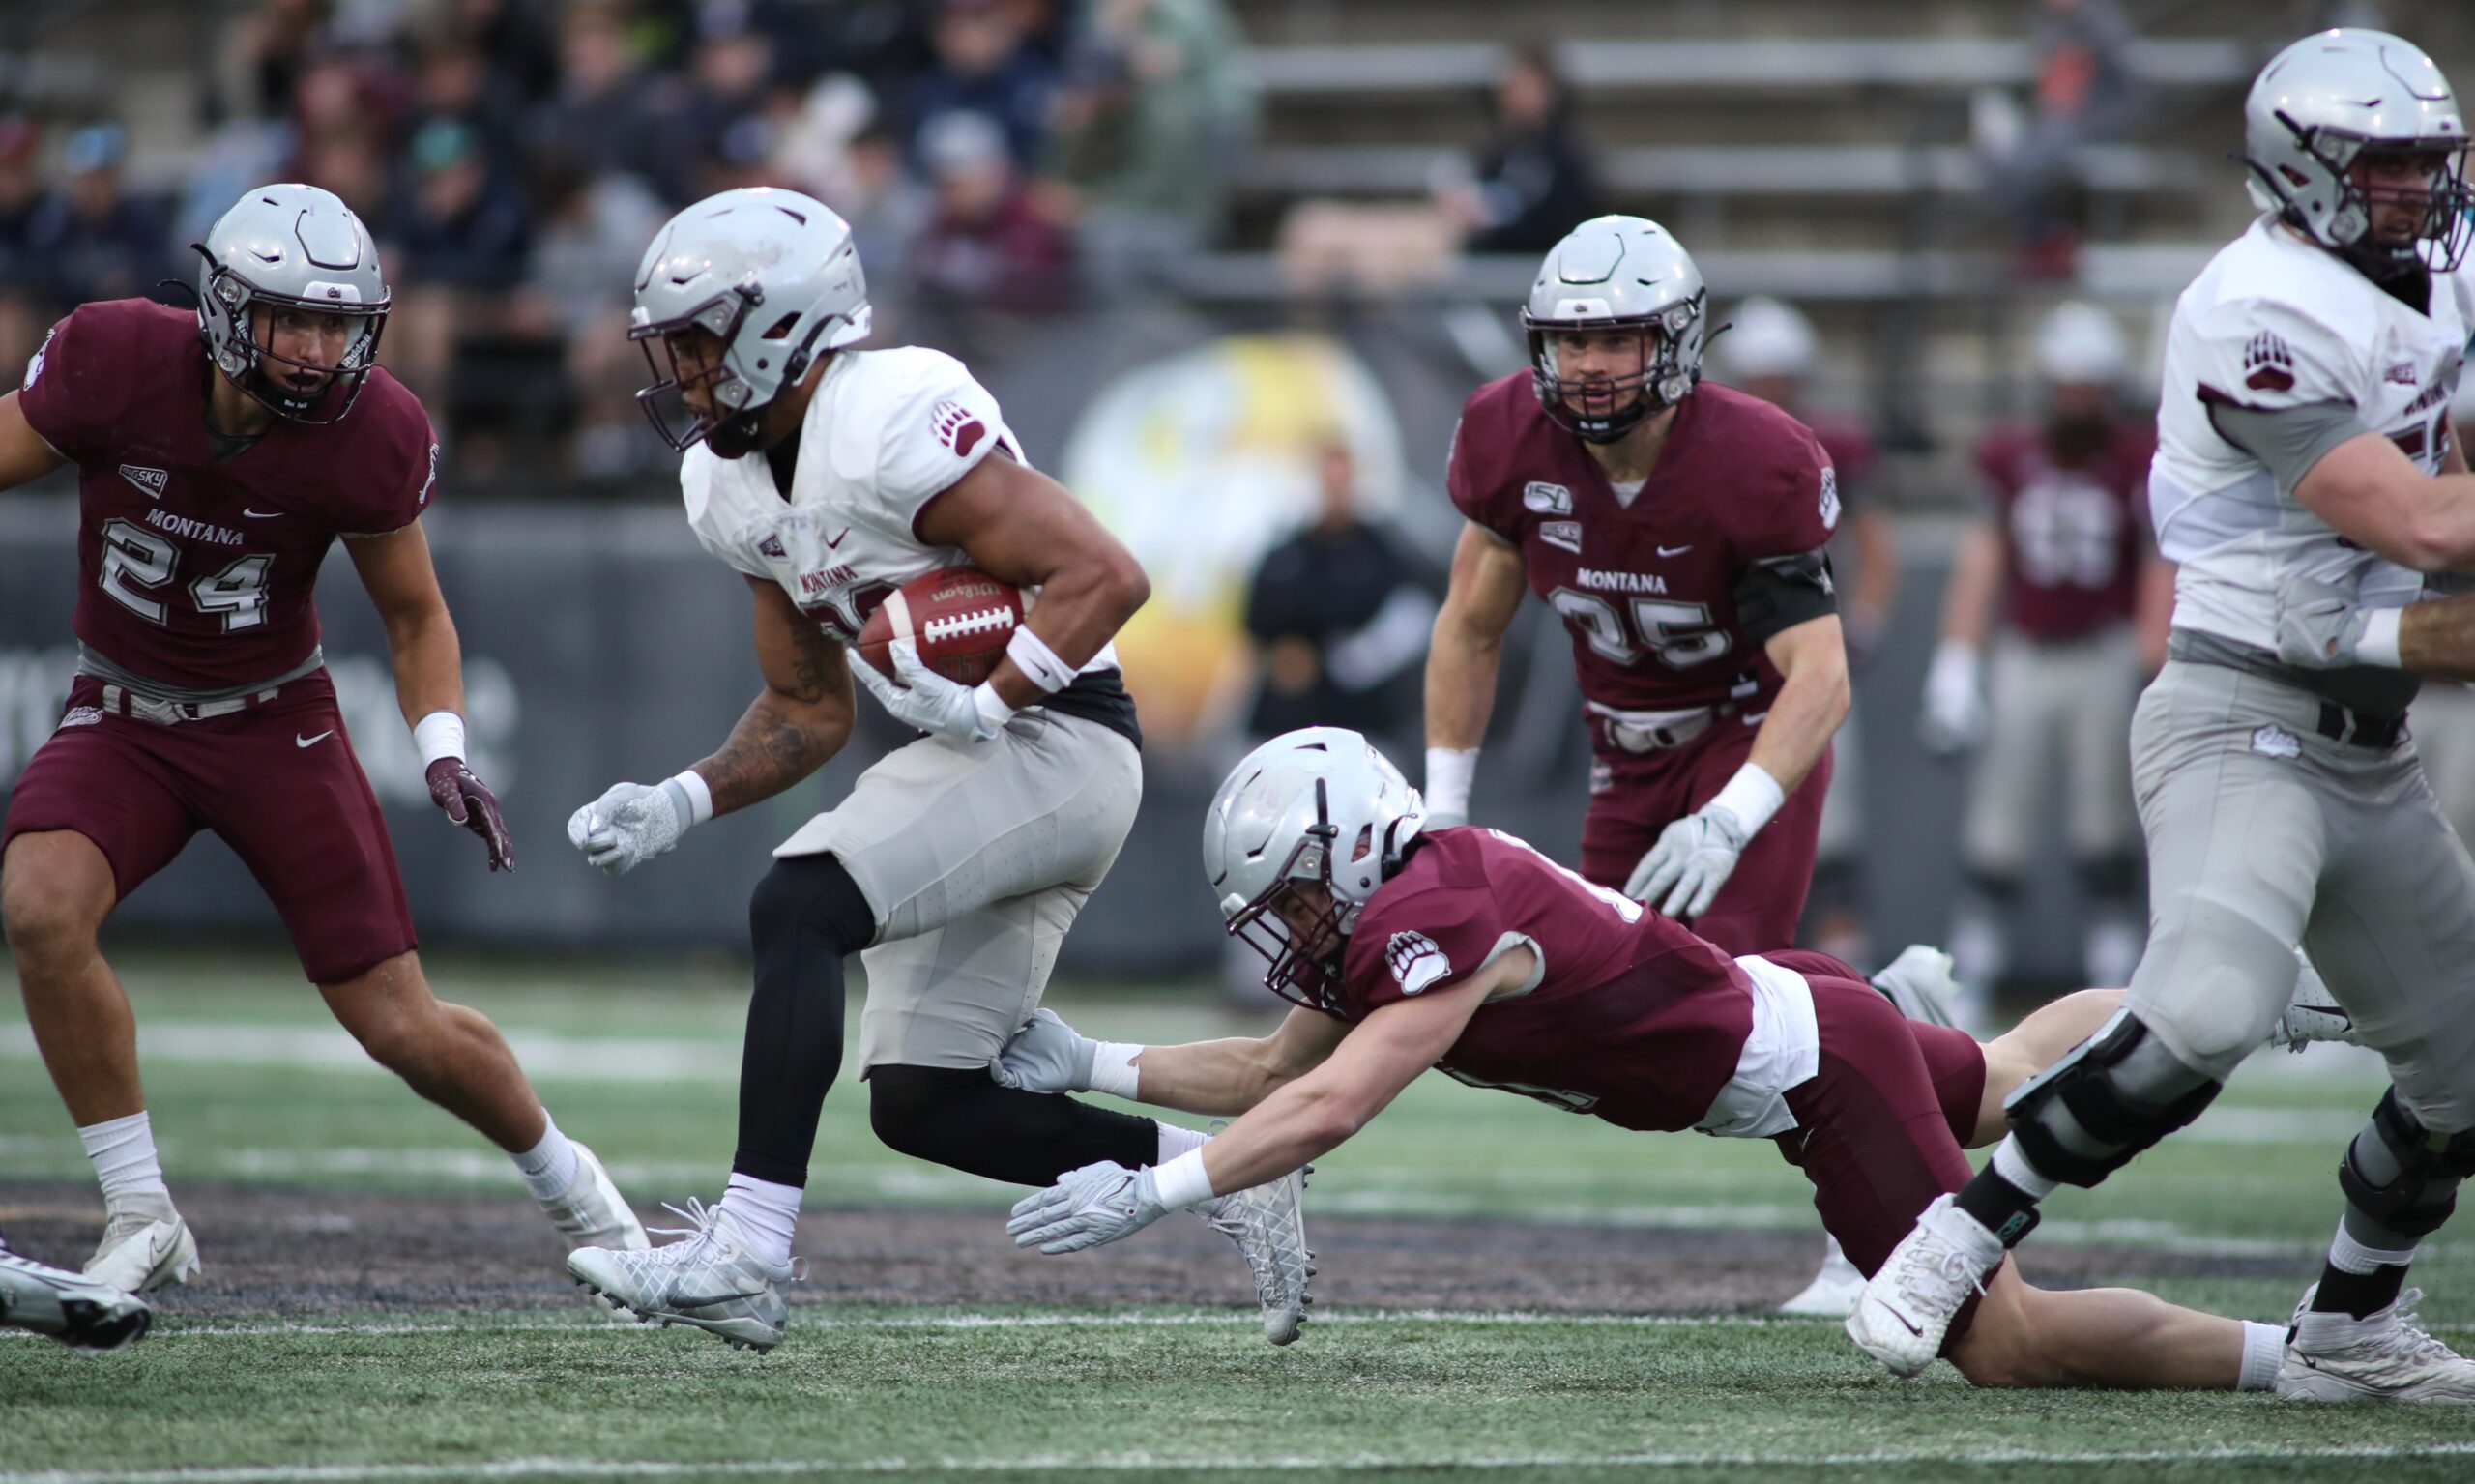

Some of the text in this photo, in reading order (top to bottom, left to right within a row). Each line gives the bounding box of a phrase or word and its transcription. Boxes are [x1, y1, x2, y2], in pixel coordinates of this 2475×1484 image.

[145, 509, 244, 545] MONTANA
[99, 517, 276, 634] 24
[799, 564, 859, 594] MONTANA
[1576, 567, 1667, 594] MONTANA
